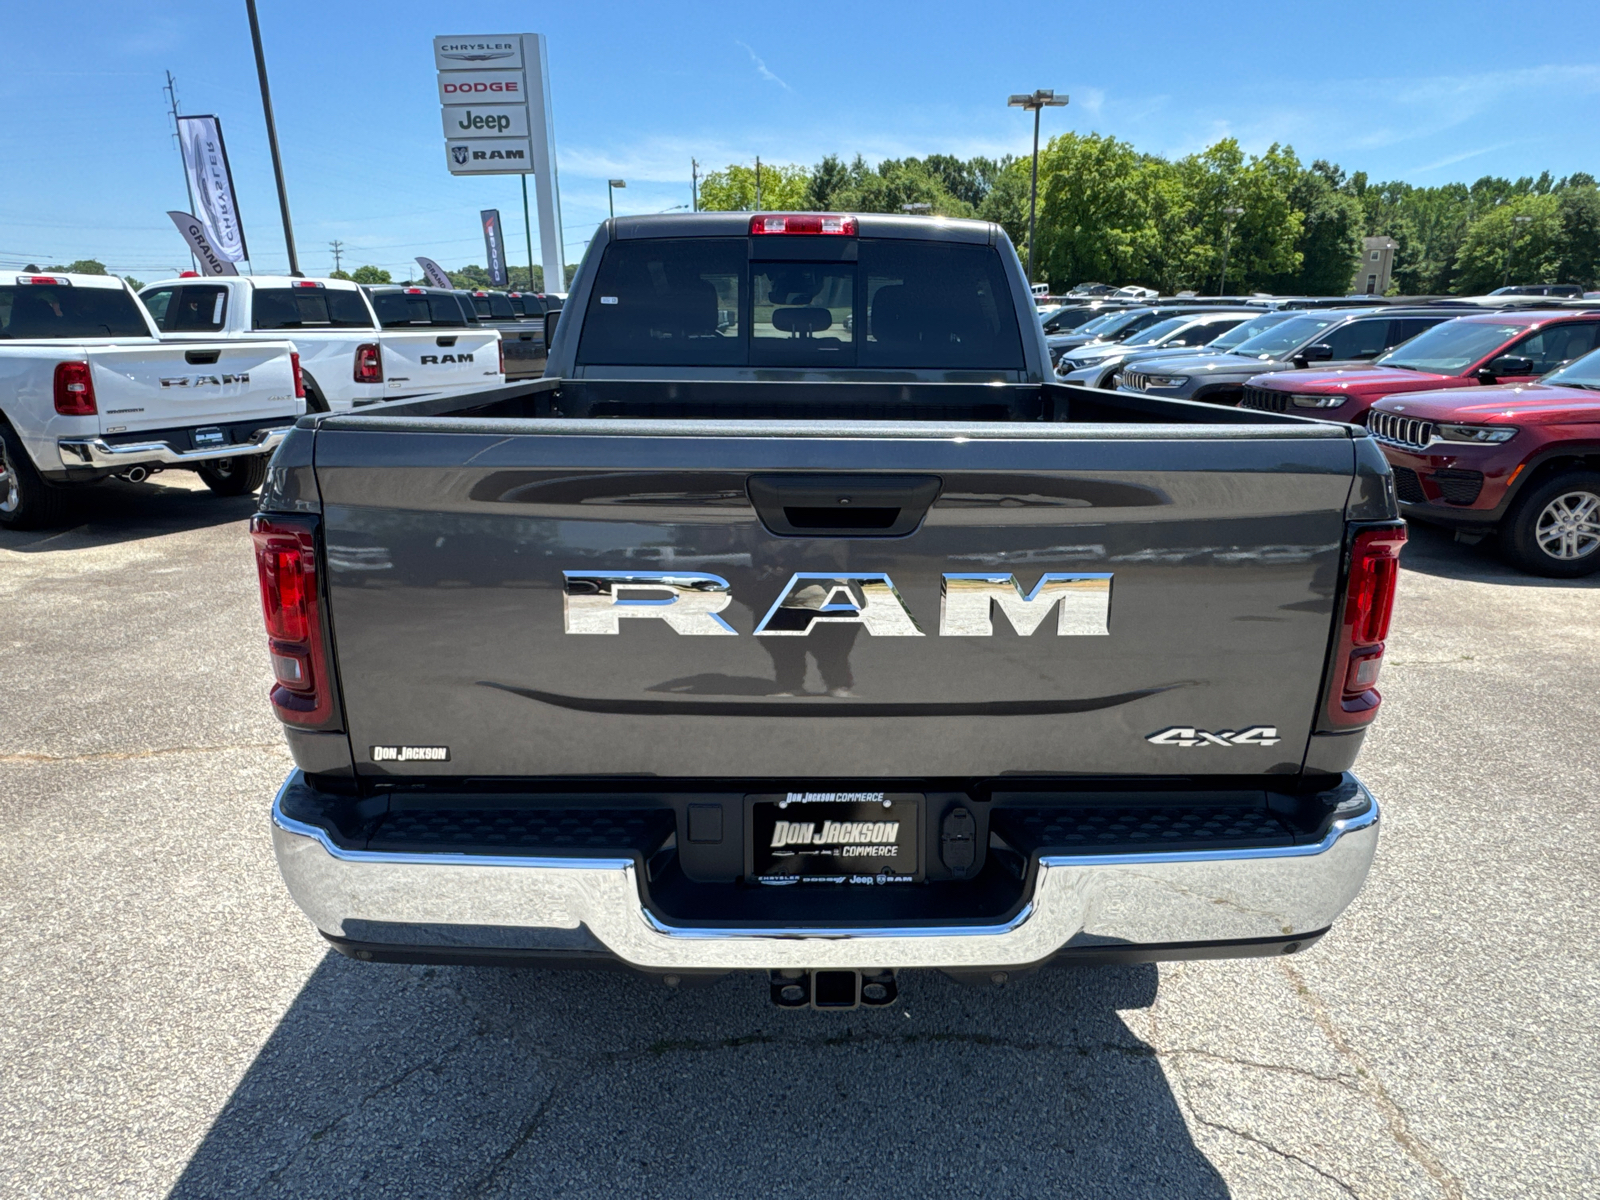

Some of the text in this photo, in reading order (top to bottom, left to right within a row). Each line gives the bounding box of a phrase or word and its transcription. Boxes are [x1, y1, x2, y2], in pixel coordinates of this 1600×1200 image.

[443, 82, 519, 93] DODGE
[458, 111, 510, 132] Jeep
[472, 150, 524, 160] RAM
[188, 224, 223, 275] GRAND
[487, 226, 500, 281] DODGE
[425, 262, 446, 289] GRAND
[420, 353, 474, 365] RAM
[159, 373, 250, 389] RAM
[562, 570, 1113, 636] RAM
[1144, 725, 1281, 747] 4x4
[836, 793, 884, 802] COMMERCE
[812, 819, 899, 844] JACKSON
[842, 845, 898, 857] COMMERCE
[849, 875, 873, 885] Jeep
